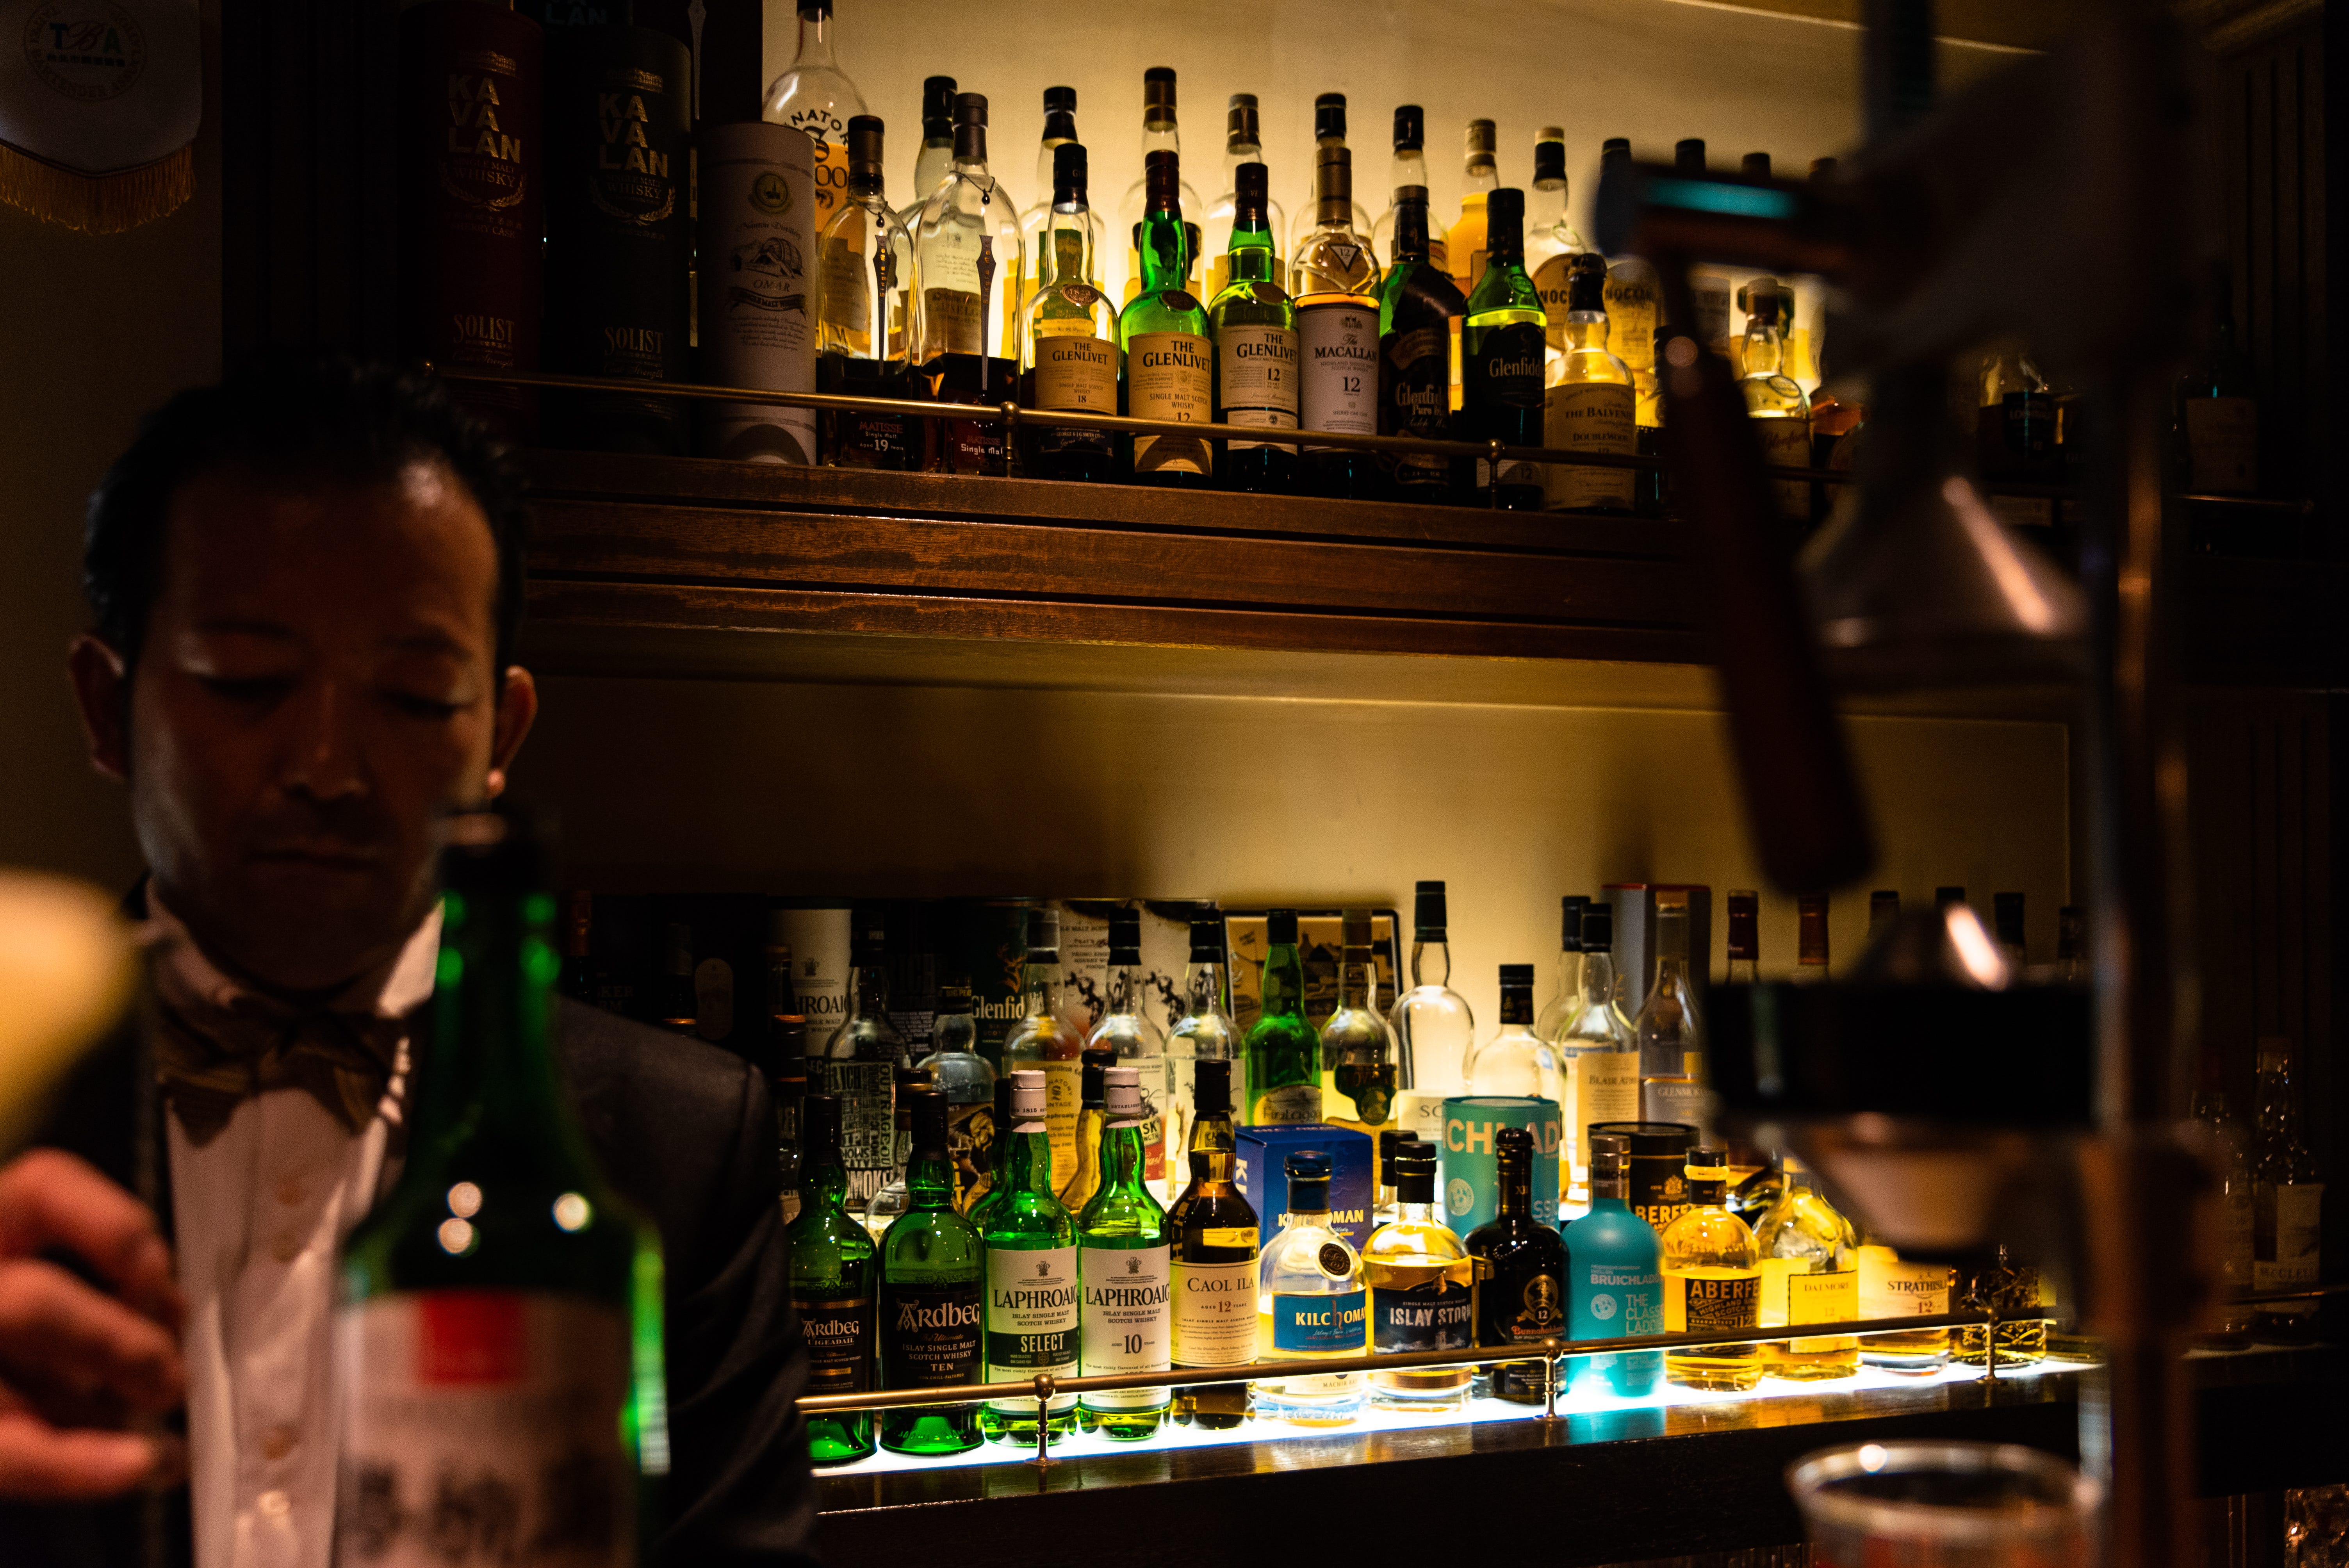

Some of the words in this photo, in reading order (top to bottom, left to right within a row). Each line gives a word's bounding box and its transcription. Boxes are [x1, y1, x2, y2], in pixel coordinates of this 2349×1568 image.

[545, 3, 608, 27] LAN
[449, 73, 500, 106] KA
[598, 92, 649, 123] KA
[449, 100, 499, 132] VA
[599, 119, 649, 149] VA
[785, 109, 848, 155] NATOR
[448, 127, 521, 164] LAN
[598, 143, 668, 178] LAN
[453, 167, 516, 188] WHISKY
[606, 182, 663, 200] WHISKY
[1339, 248, 1351, 258] 12
[753, 279, 791, 292] OMAR
[1540, 289, 1573, 305] NOC
[453, 313, 515, 344] SOLIST
[604, 326, 663, 356] SOLIST
[1264, 333, 1283, 344] THE
[1341, 333, 1358, 346] The
[1074, 342, 1092, 351] THE
[1171, 340, 1194, 353] THE
[1052, 350, 1108, 365] GLENLIVET
[1314, 346, 1377, 362] MACALLAN
[1143, 352, 1210, 374] GLENLIVET
[1268, 368, 1280, 381] 12
[1343, 376, 1361, 393] 12
[1077, 395, 1087, 403] 18
[1171, 401, 1195, 410] WHISKY
[1177, 412, 1191, 422] 12
[1565, 411, 1583, 419] THE
[859, 421, 904, 434] MATISSE
[874, 439, 889, 452] 19
[961, 443, 986, 456] Single
[1520, 468, 1532, 480] 12
[597, 984, 636, 998] KER
[1047, 1078, 1073, 1096] NATORY
[1420, 1104, 1443, 1118] SC
[1142, 1123, 1157, 1135] SK
[1187, 1277, 1232, 1292] CAOL
[1237, 1277, 1254, 1291] ILA
[1218, 1301, 1232, 1312] 12
[1625, 1293, 1648, 1307] THE
[1918, 1300, 1932, 1314] 12
[1698, 1299, 1742, 1316] HIGHLAND
[895, 1297, 980, 1333] Ardbeg
[1389, 1307, 1434, 1327] ISLAY
[1538, 1310, 1549, 1320] 12
[800, 1317, 860, 1339] Ardbeg
[807, 1337, 855, 1346] UIGEADAIL
[933, 1333, 964, 1342] Ultimate
[1021, 1333, 1065, 1352] SELECT
[1124, 1333, 1142, 1354] 10
[902, 1343, 925, 1352] ISLAY
[927, 1343, 957, 1352] SINGLE
[959, 1340, 976, 1350] MALT
[943, 1350, 972, 1360] WHISKY
[930, 1362, 954, 1372] TEN
